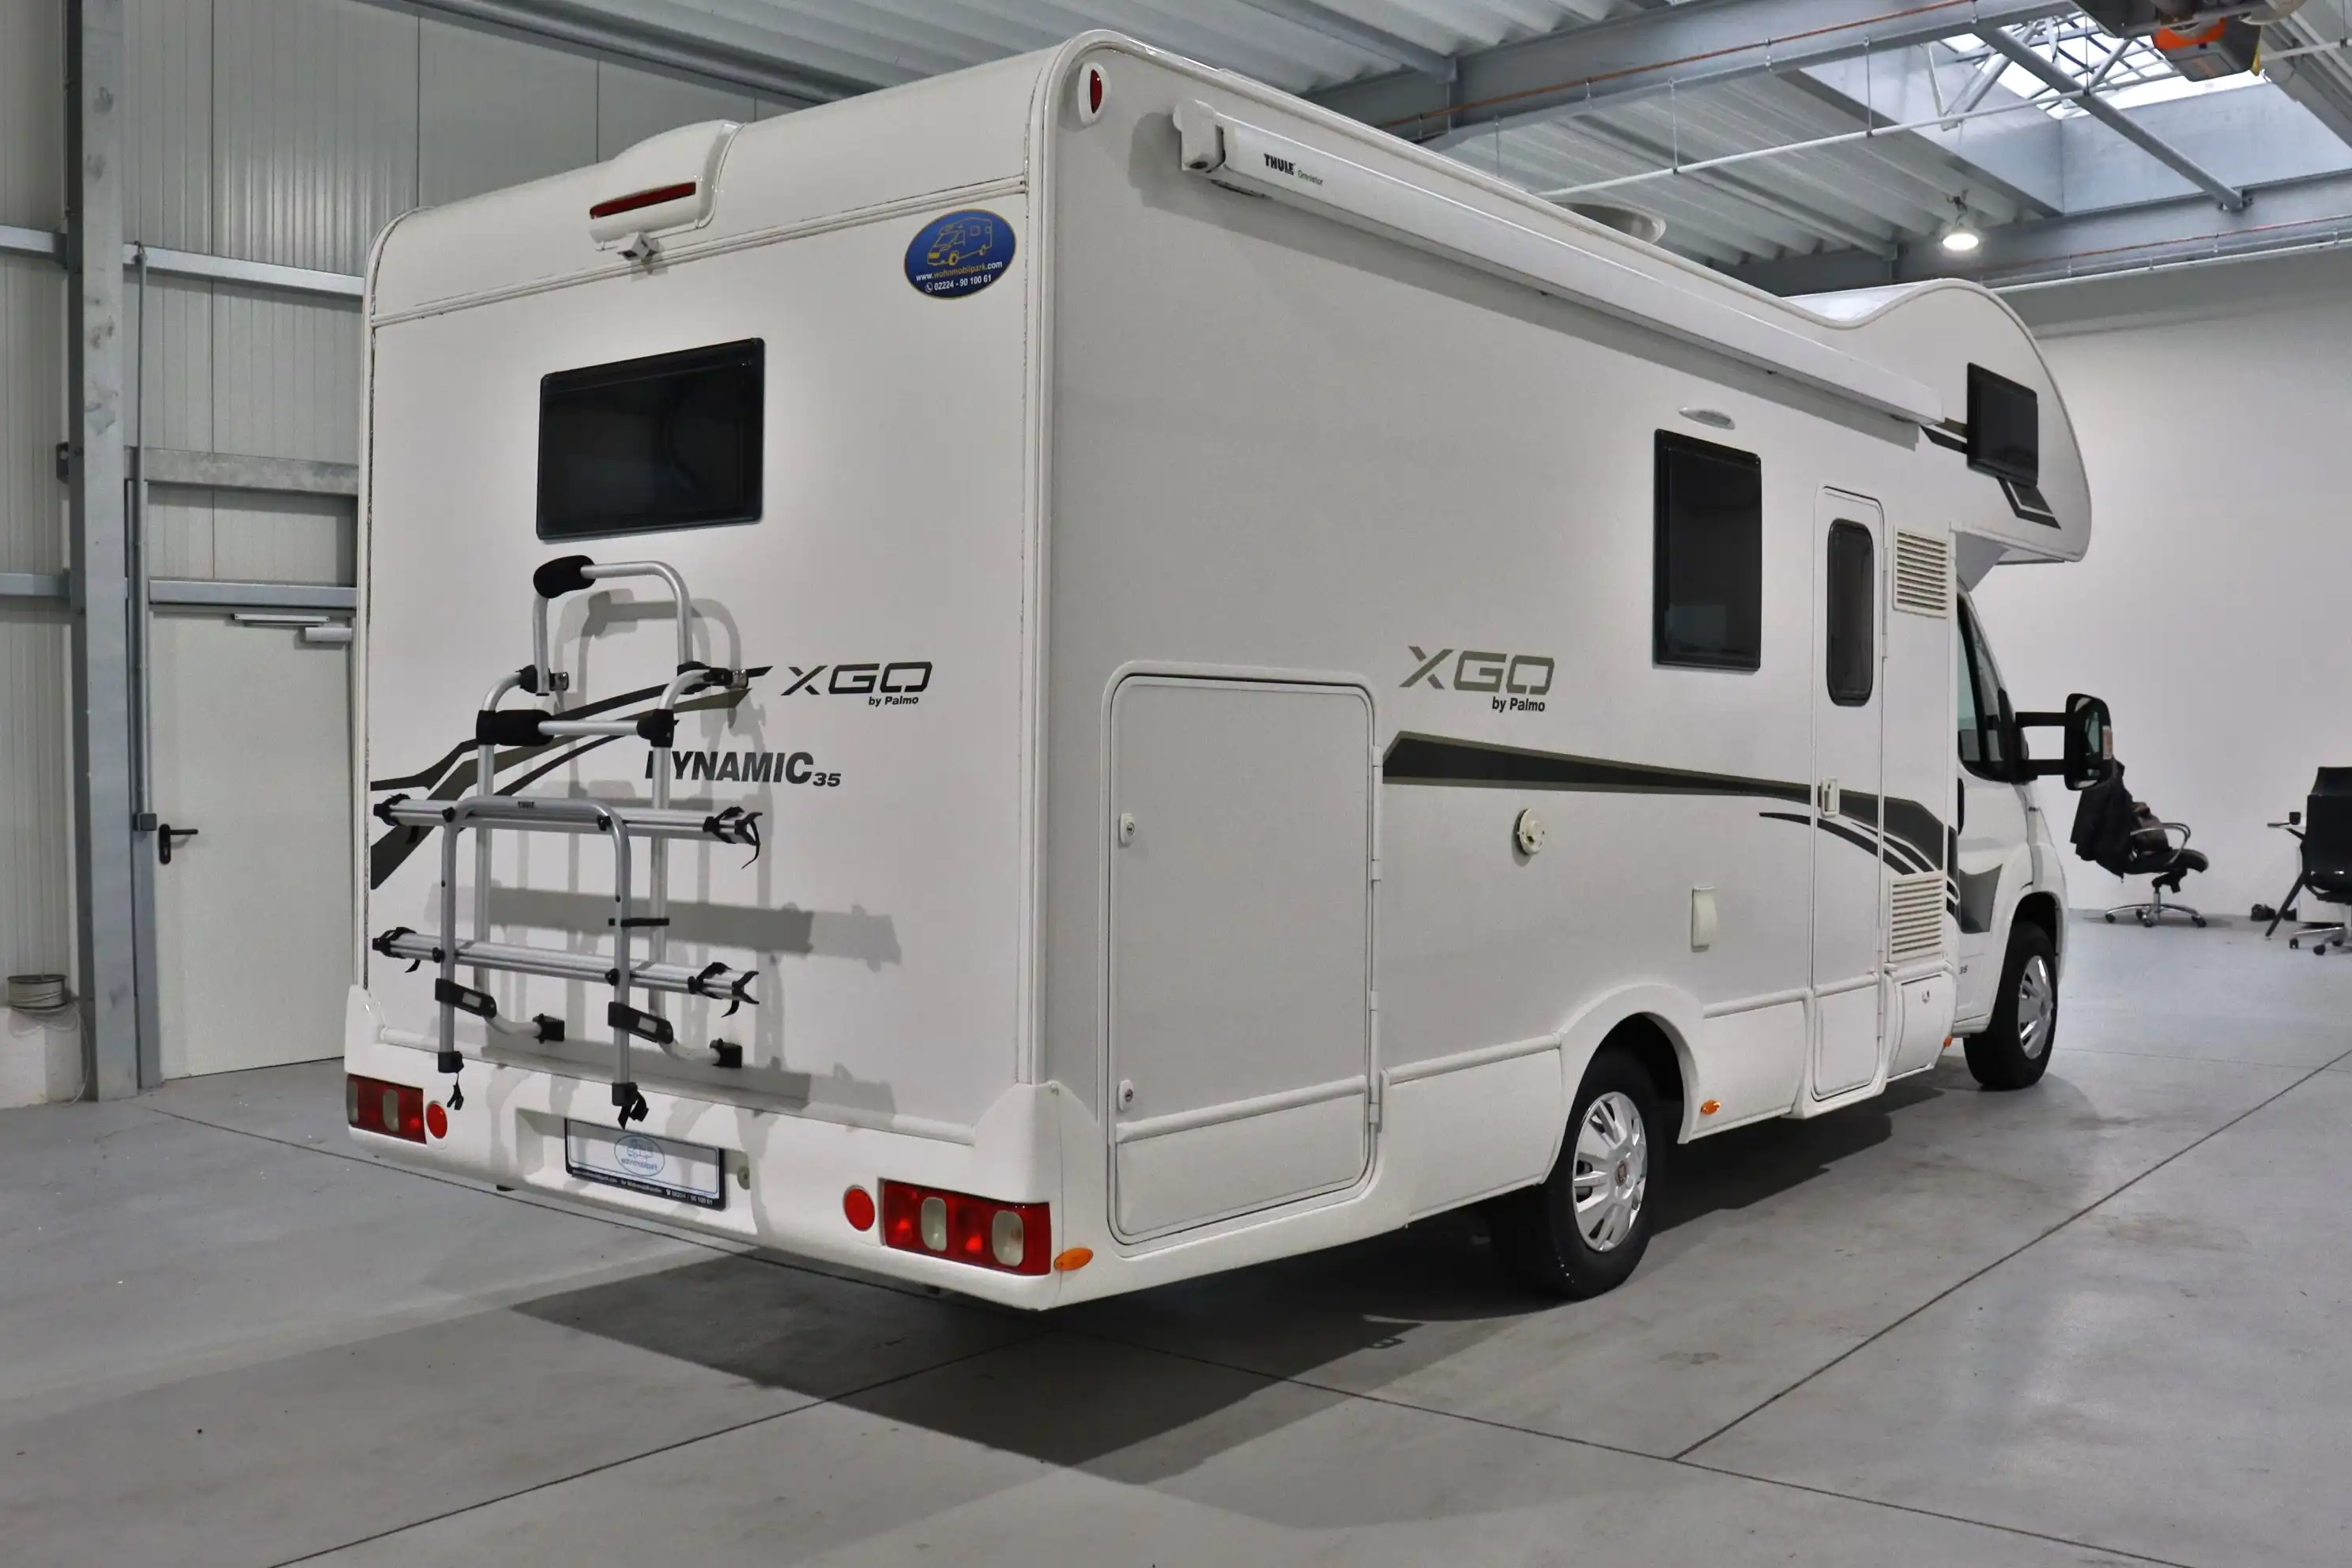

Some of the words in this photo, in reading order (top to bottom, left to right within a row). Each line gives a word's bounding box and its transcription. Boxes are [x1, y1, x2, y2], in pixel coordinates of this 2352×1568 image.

[1264, 153, 1295, 175] THULE
[915, 262, 1002, 281] www.wohnmobilpark.com
[934, 280, 954, 291] 02224
[959, 278, 968, 287] 90
[970, 276, 982, 285] 100
[780, 661, 933, 695] XGO
[1399, 645, 1555, 695] XGO
[869, 695, 881, 707] by
[884, 695, 919, 705] Palmo
[1492, 696, 1506, 712] by
[1510, 697, 1546, 711] Palmo
[812, 772, 842, 787] 35
